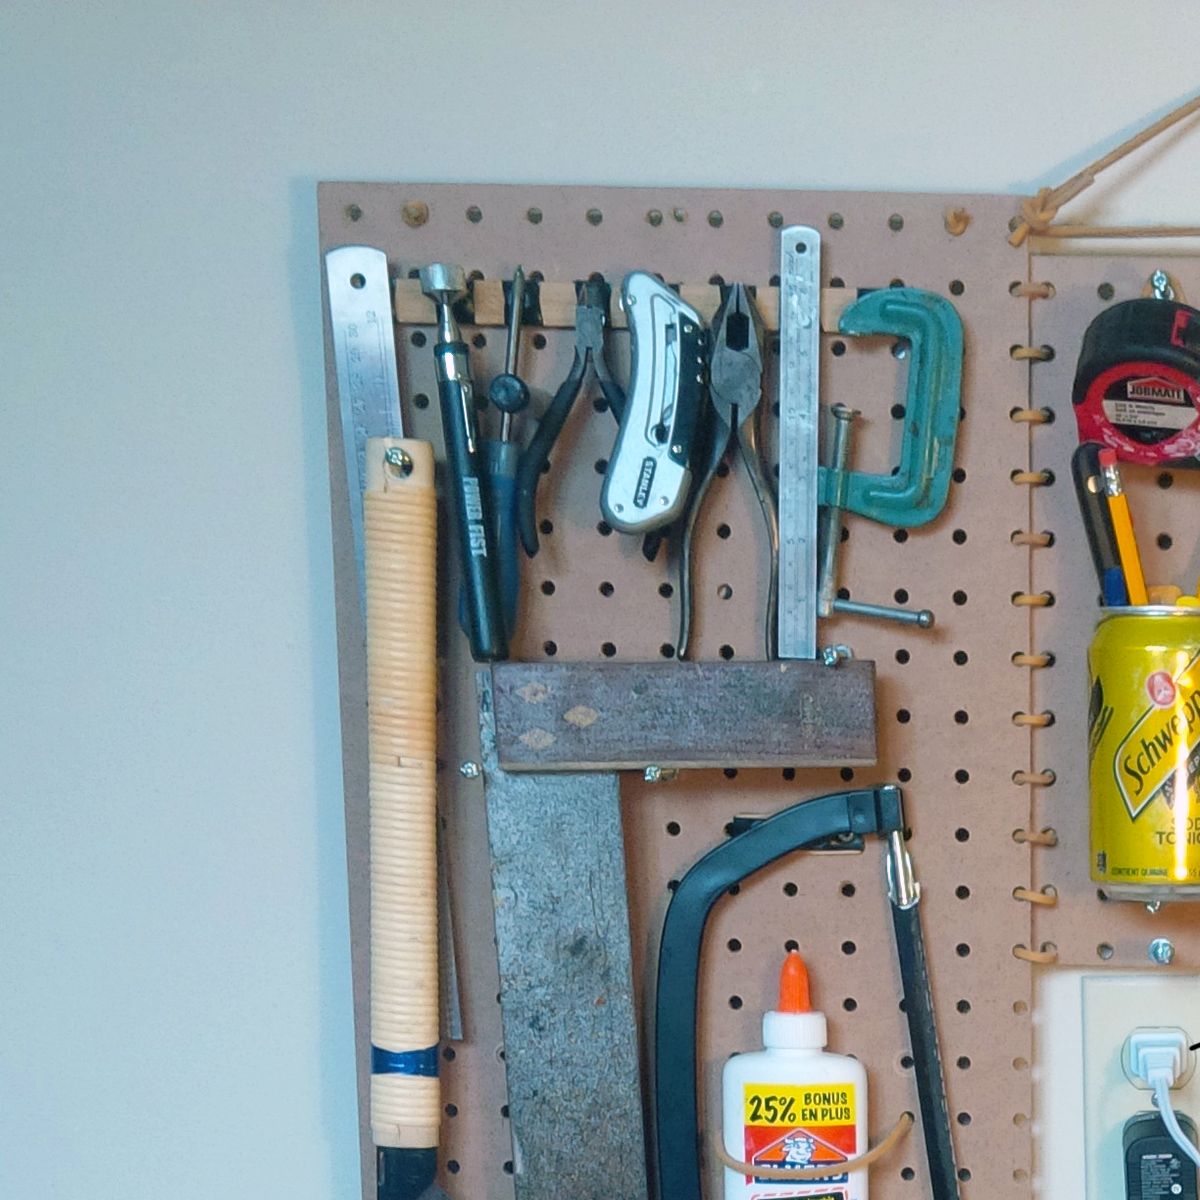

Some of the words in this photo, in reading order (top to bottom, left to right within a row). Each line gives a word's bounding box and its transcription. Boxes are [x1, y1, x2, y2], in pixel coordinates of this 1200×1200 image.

[803, 1092, 848, 1106] BONUS
[749, 1094, 797, 1124] 25%
[801, 1108, 818, 1121] EN
[821, 1107, 851, 1121] PLUS
